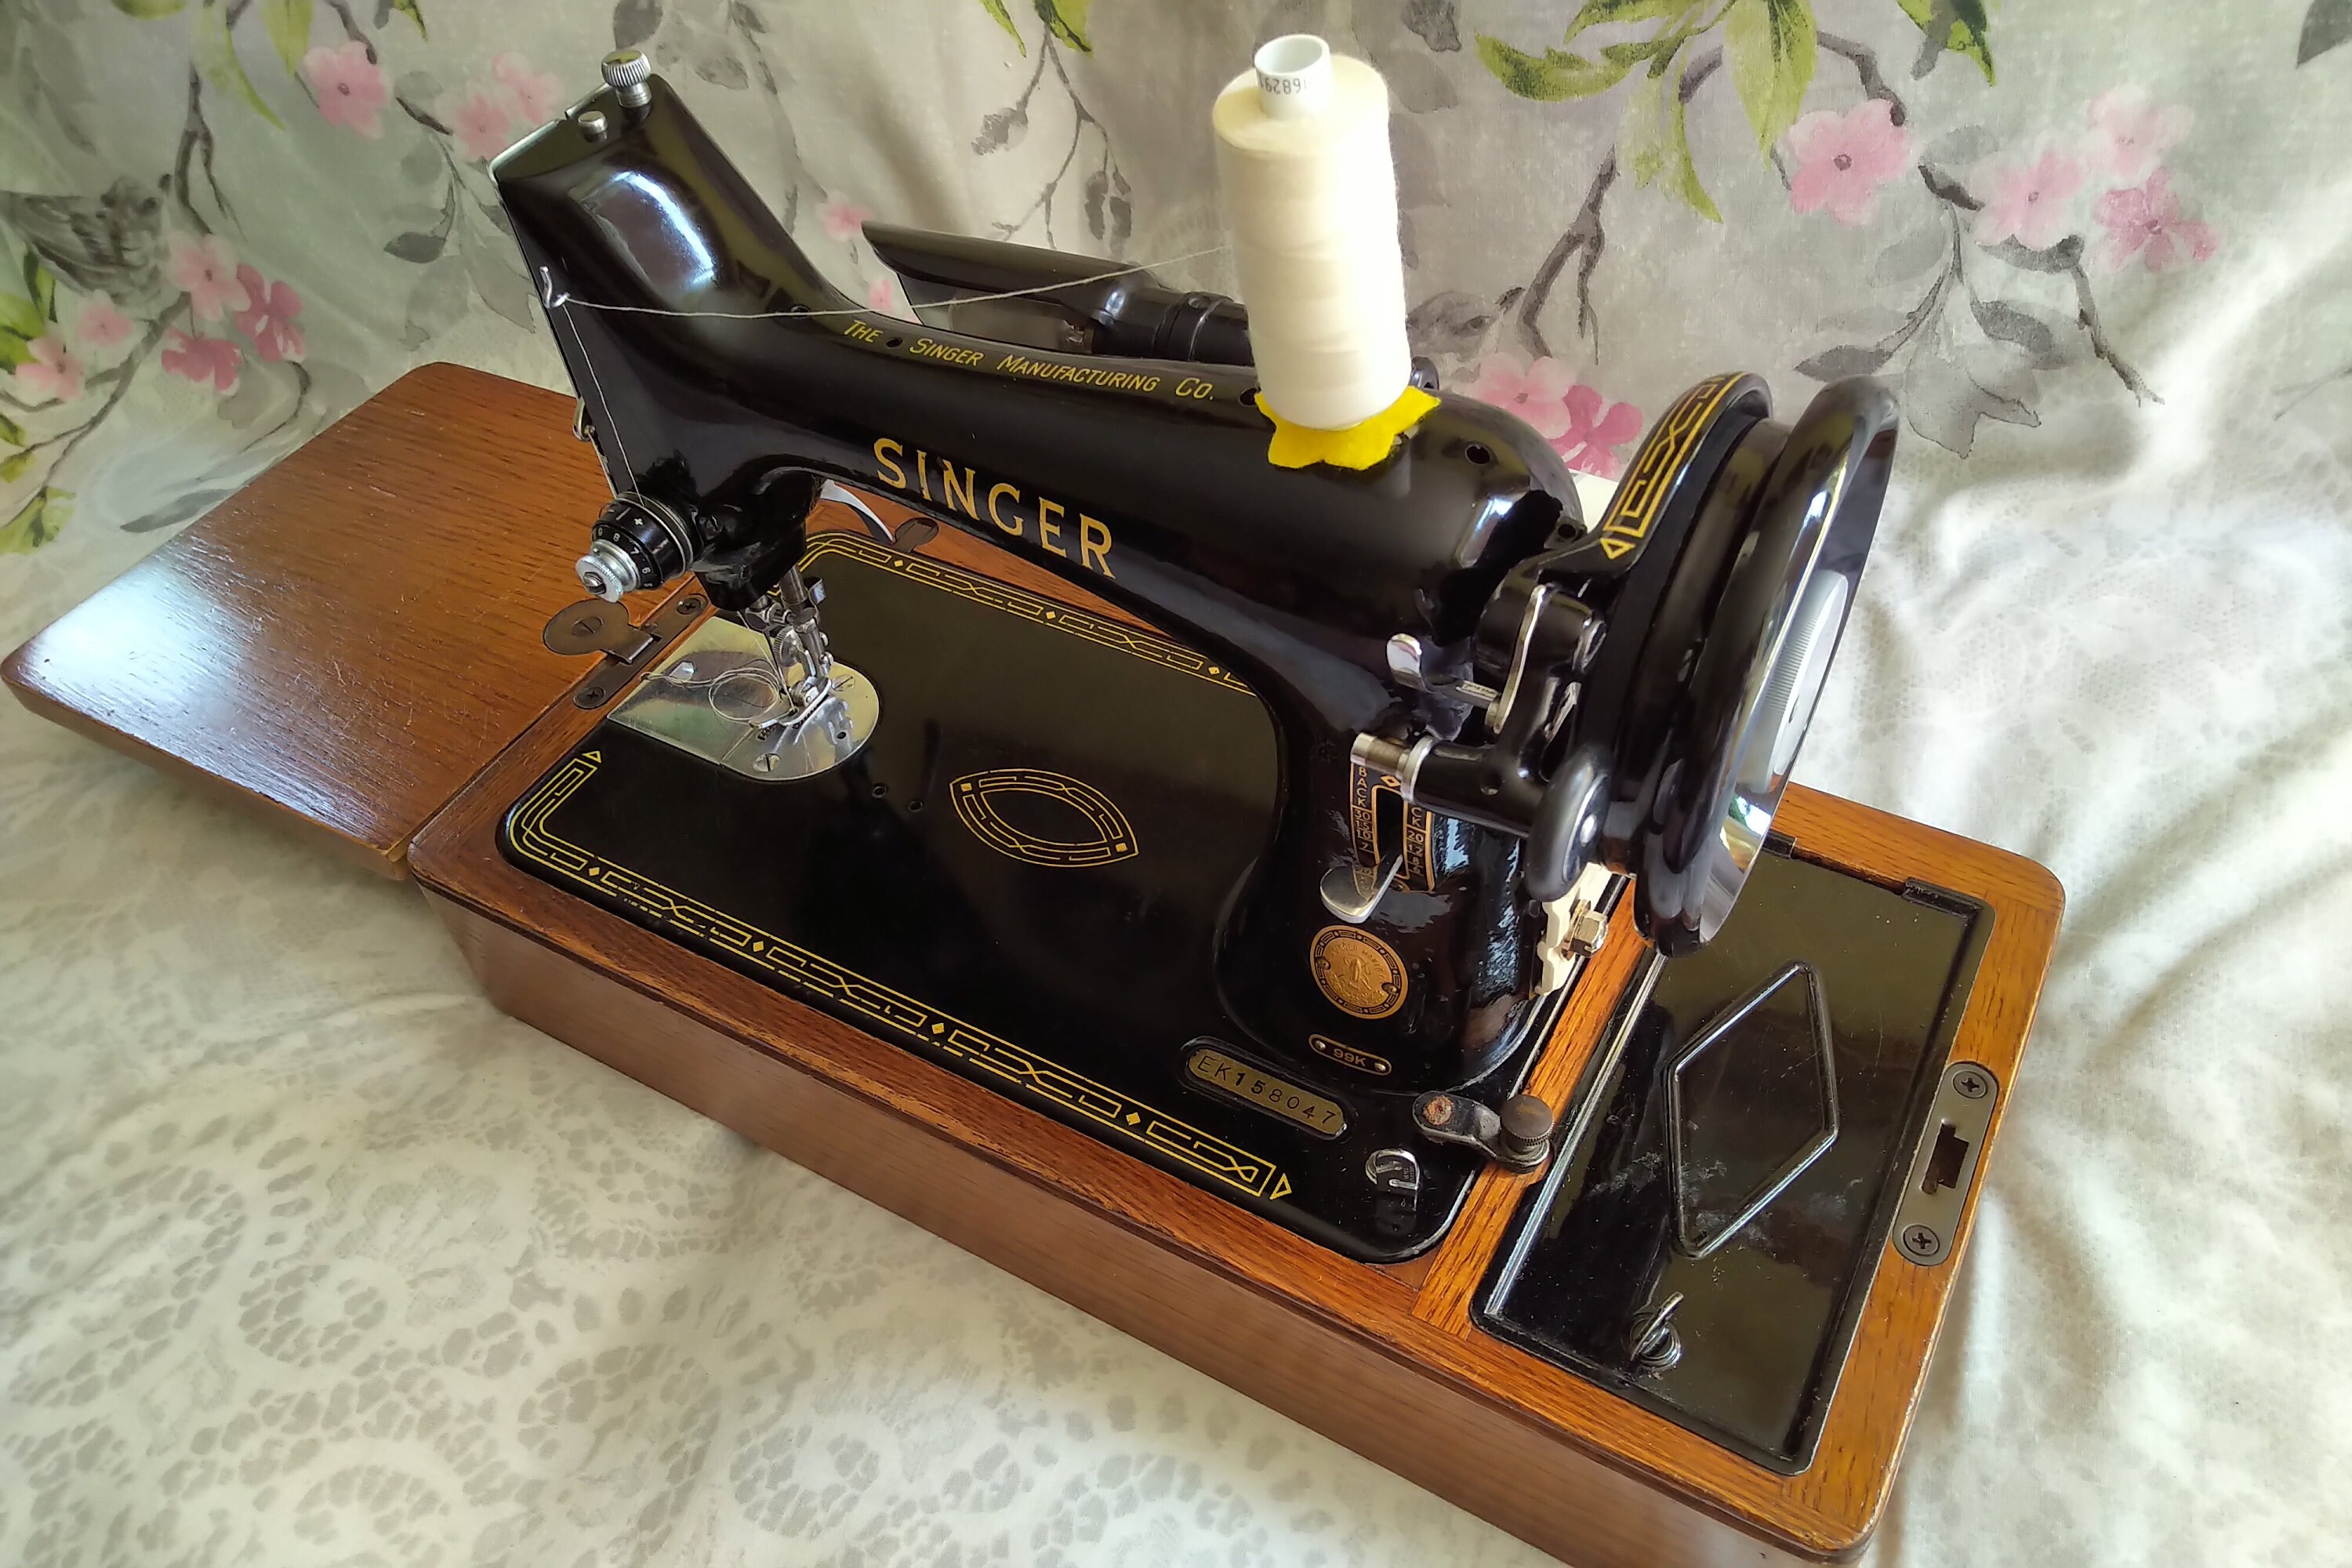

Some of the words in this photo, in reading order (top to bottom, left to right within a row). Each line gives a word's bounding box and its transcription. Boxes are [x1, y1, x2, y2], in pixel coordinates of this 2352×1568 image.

[844, 321, 884, 343] THE
[910, 339, 983, 366] SINGER
[997, 355, 1160, 393] MANUFACTURING
[873, 437, 1116, 579] SINGER
[613, 532, 620, 542] 8
[1356, 767, 1368, 808] BACK
[1355, 809, 1370, 821] 30
[1411, 807, 1422, 826] CK
[1356, 820, 1370, 831] 15
[1356, 829, 1371, 840] 10
[1407, 830, 1424, 843] 20
[1408, 844, 1423, 856] 12
[1333, 1047, 1367, 1067] 99K
[1196, 1054, 1337, 1124] EK158047
